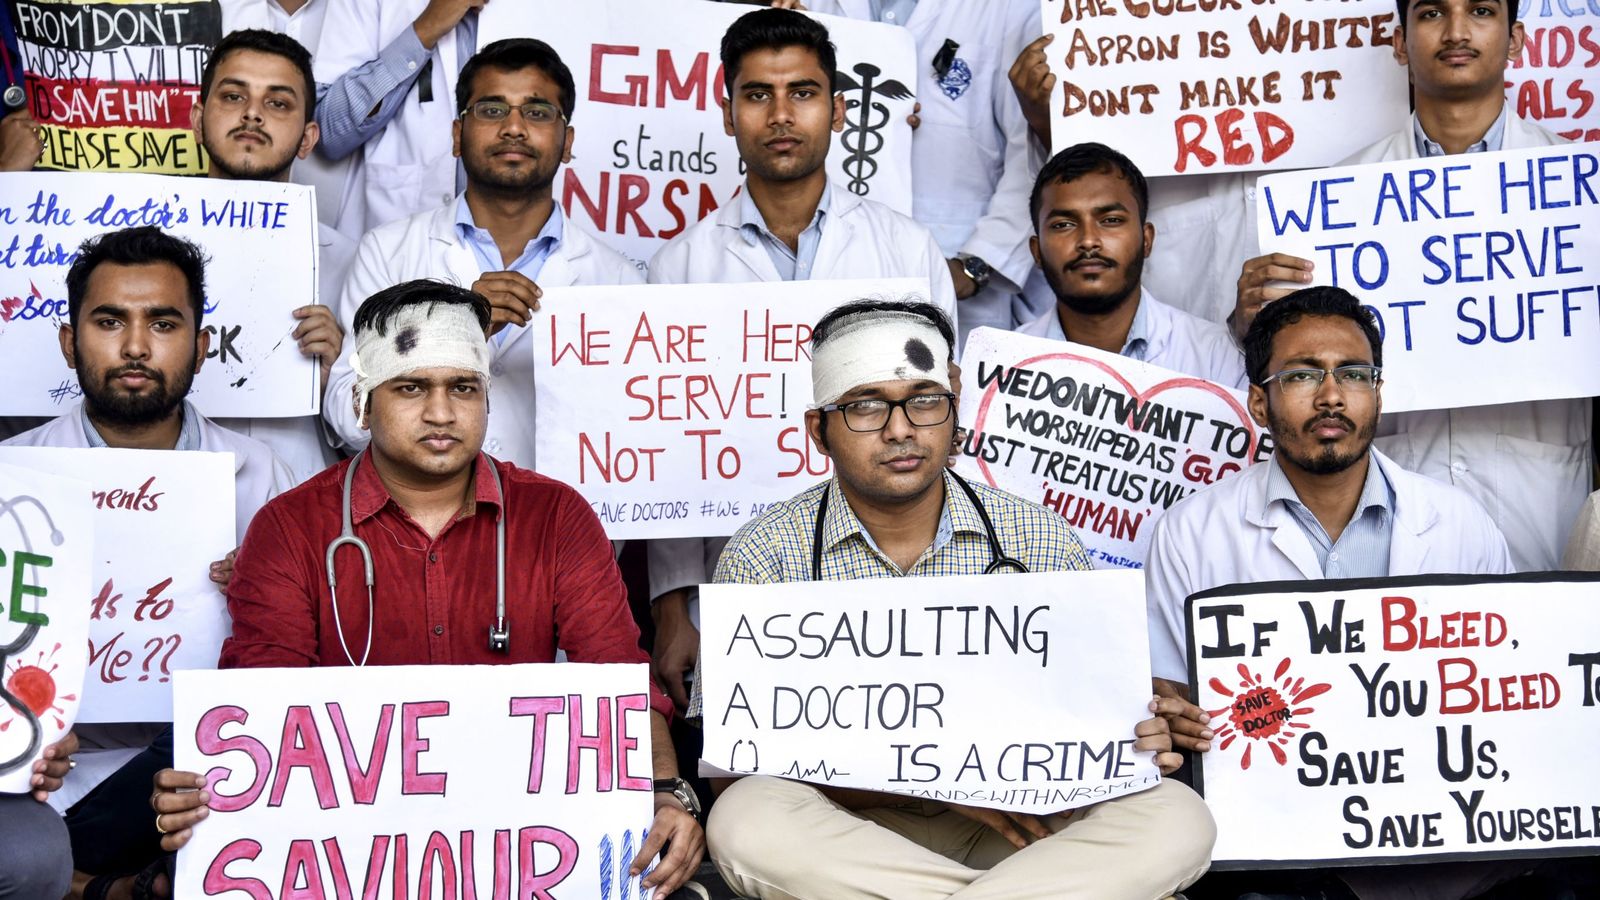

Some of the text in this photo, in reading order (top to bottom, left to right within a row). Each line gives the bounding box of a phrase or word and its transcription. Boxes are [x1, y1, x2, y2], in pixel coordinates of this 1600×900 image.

[17, 3, 84, 50] FROM
[1064, 12, 1394, 71] APRON IS WHITE
[23, 40, 95, 86] WORRY
[101, 50, 119, 86] I
[25, 76, 51, 120] TO
[51, 85, 120, 124] SAVE
[1062, 70, 1342, 117] DONT MAKE IT
[128, 131, 187, 168] SAVE
[612, 124, 718, 174] stands
[1174, 107, 1295, 173] RED
[25, 190, 76, 226] the
[201, 198, 289, 230] WHITE
[1264, 153, 1600, 237] WE ARE HER
[1314, 224, 1584, 290] TO SERVE
[742, 309, 813, 362] HER
[1456, 285, 1600, 346] SUFF
[1210, 419, 1250, 460] TO
[632, 500, 689, 522] DOCTORS
[134, 577, 174, 622] to
[726, 605, 1050, 667] ASSAULTING
[1199, 603, 1279, 659] IF
[1298, 599, 1366, 655] WE
[722, 682, 945, 730] A DOCTOR
[1236, 690, 1273, 717] SAVE
[1349, 662, 1429, 718] YOU
[1437, 657, 1562, 715] BLEED
[1242, 707, 1293, 734] DOCTOR
[195, 694, 653, 813] SAVE THE
[888, 740, 1136, 783] IS A CRIME
[1297, 731, 1405, 787] SAVE
[1342, 795, 1445, 850] SAVE
[203, 826, 579, 900] SAVIOUR
